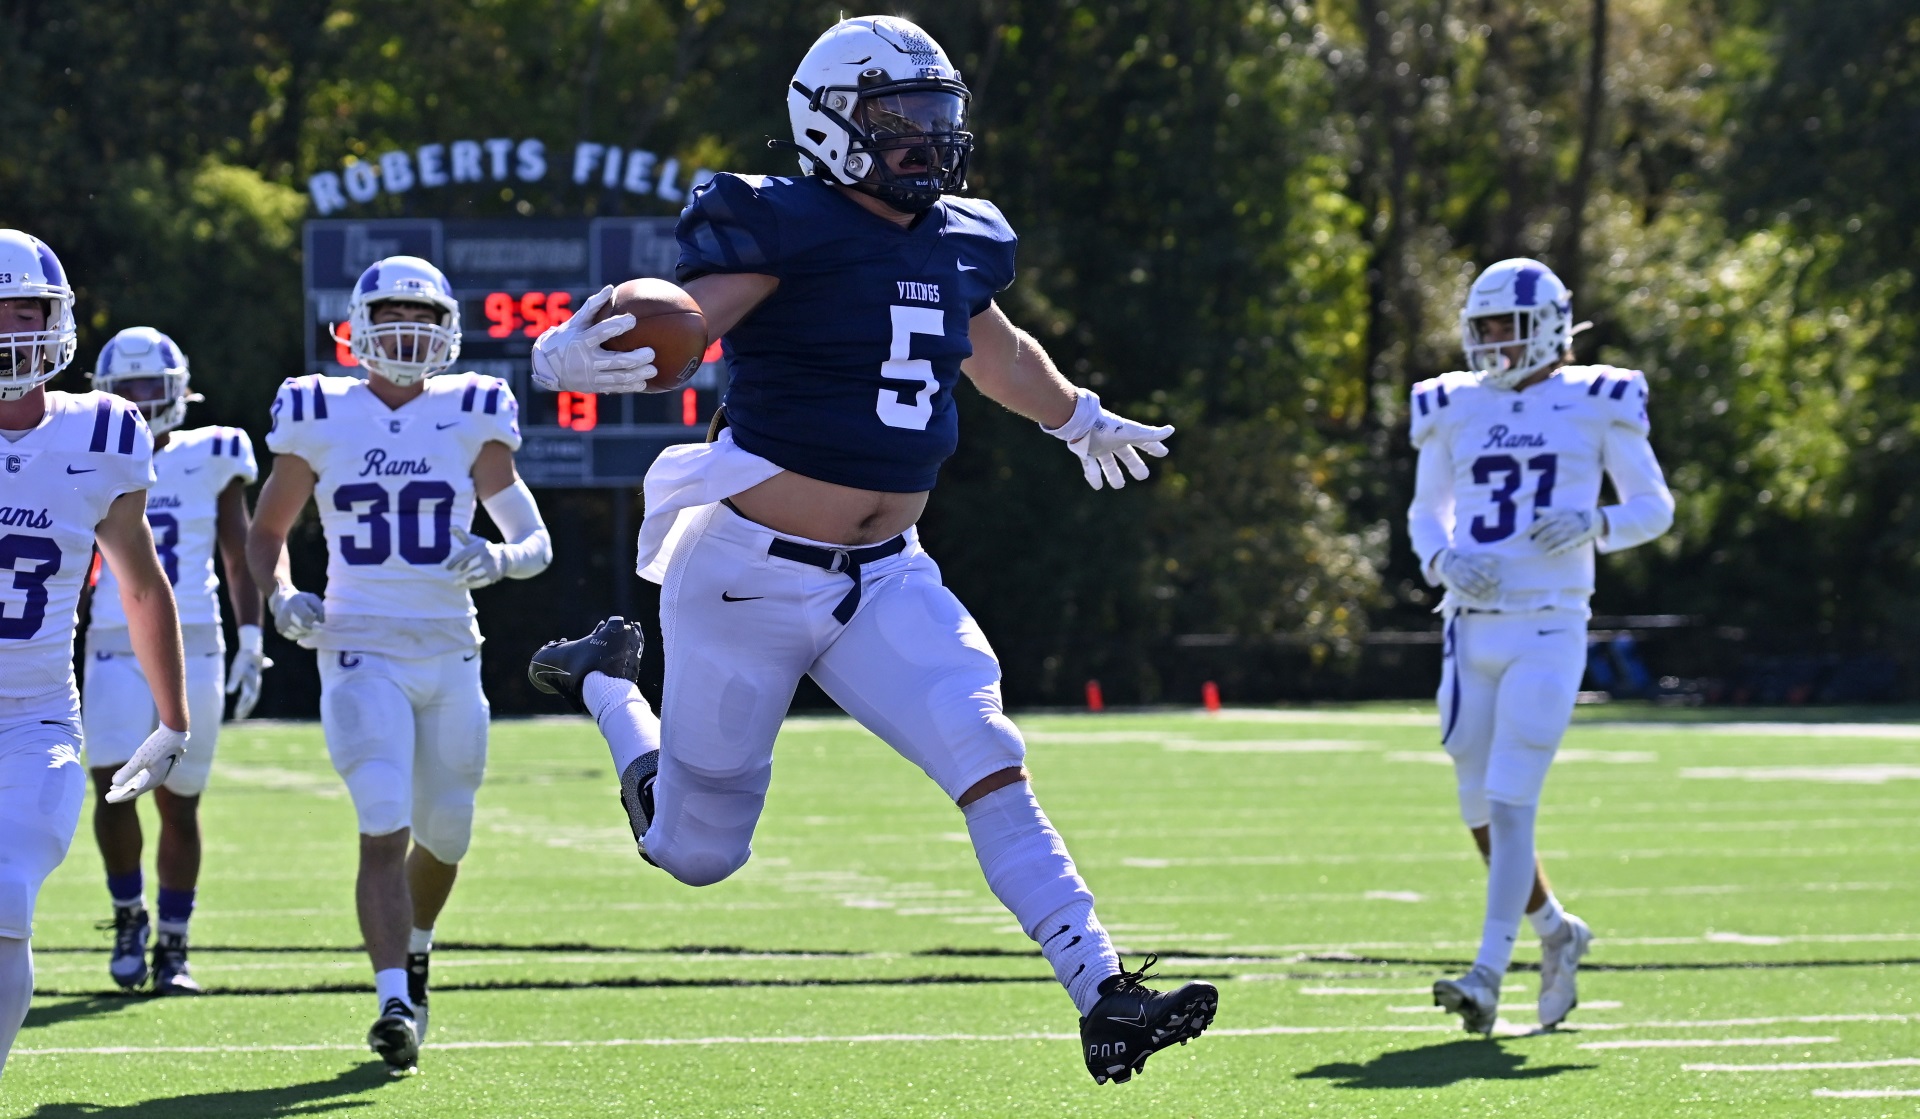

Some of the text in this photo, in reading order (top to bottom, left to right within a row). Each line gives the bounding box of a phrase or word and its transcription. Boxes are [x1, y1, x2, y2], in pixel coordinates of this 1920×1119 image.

[308, 138, 548, 214] ROBERTS
[897, 281, 940, 303] VIKINGS
[876, 304, 945, 431] 5
[557, 391, 598, 432] 13
[682, 387, 697, 427] 1
[1482, 424, 1547, 449] Rams
[6, 454, 21, 473] C
[358, 448, 432, 476] Rams
[0, 506, 53, 530] ams
[1470, 453, 1558, 543] 31
[333, 480, 456, 566] 30
